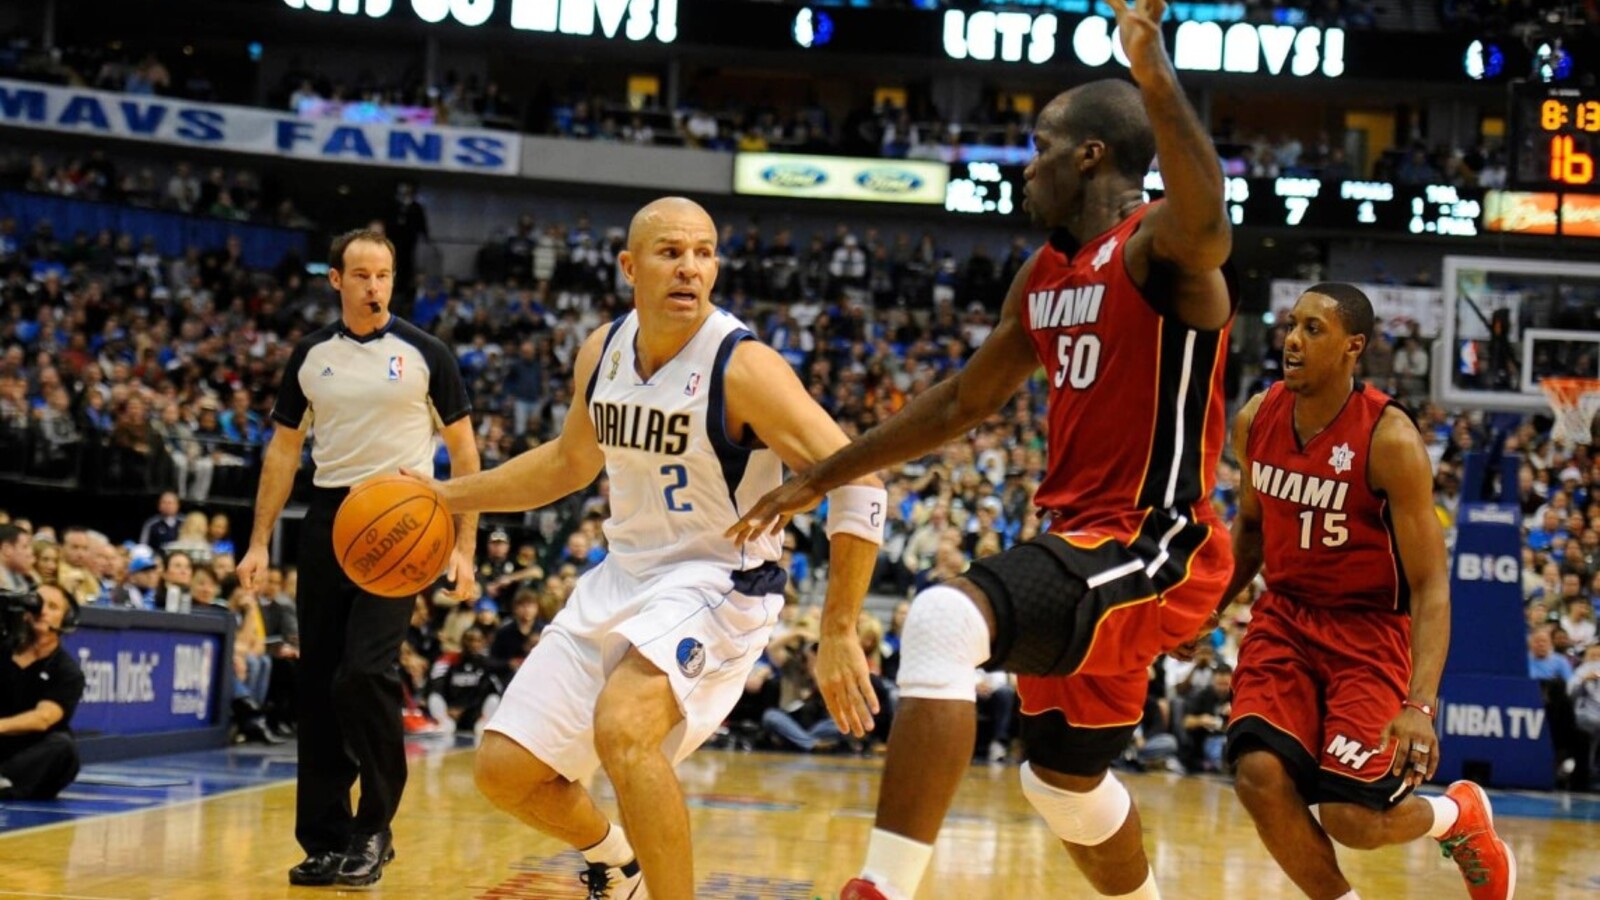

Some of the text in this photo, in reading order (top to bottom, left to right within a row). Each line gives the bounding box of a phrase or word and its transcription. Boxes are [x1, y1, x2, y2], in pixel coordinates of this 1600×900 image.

[943, 9, 1058, 64] LETS
[1174, 19, 1345, 78] MAVS!
[0, 87, 504, 168] MAVS FANS
[1541, 99, 1600, 131] 8:13
[1550, 135, 1593, 184] 16
[1285, 197, 1310, 225] 7
[1028, 284, 1105, 330] MIAMI
[1054, 334, 1101, 389] 50
[593, 402, 690, 456] DALLAS
[660, 464, 693, 512] 2
[1251, 461, 1349, 511] MIAMI
[353, 513, 421, 578] SPALDING
[1299, 511, 1349, 549] 15
[1446, 704, 1545, 740] NBA TV
